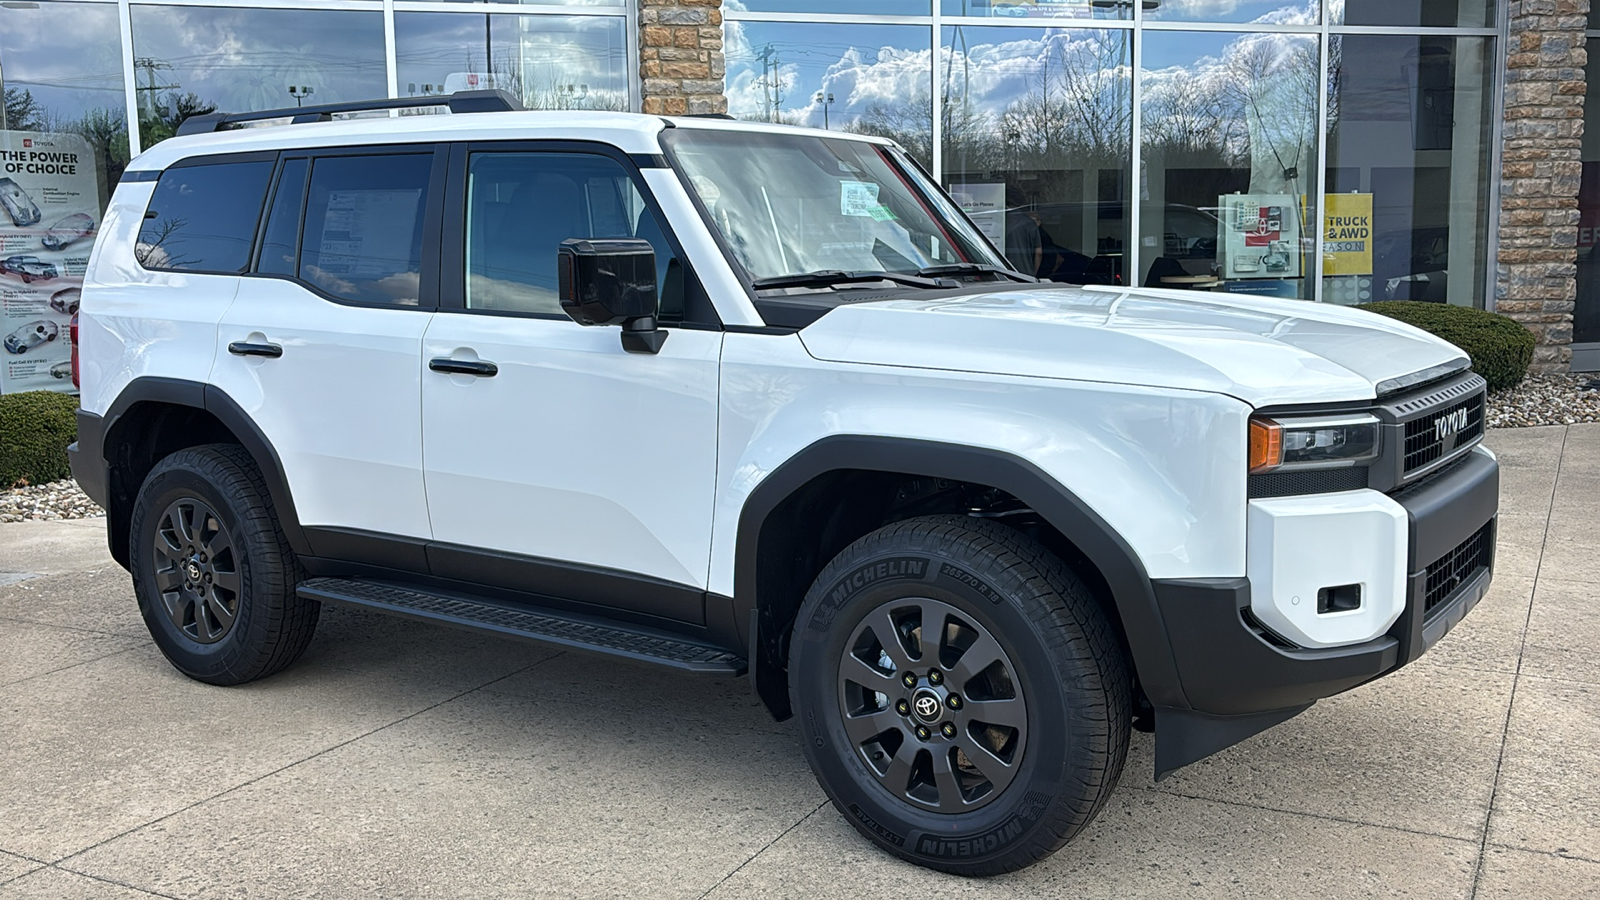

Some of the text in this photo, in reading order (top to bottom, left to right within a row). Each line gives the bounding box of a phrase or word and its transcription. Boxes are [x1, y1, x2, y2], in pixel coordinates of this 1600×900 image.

[0, 150, 78, 164] THE POWER
[5, 163, 76, 174] OF CHOICE
[1328, 216, 1368, 226] TRUCK
[1328, 228, 1369, 238] & AWD
[1434, 407, 1468, 440] TOYOTA
[832, 561, 923, 606] MICHELIN
[943, 565, 1000, 602] 265/70 R 18
[855, 808, 900, 844] LTX TRAIL
[922, 818, 1022, 856] MICHELIN
